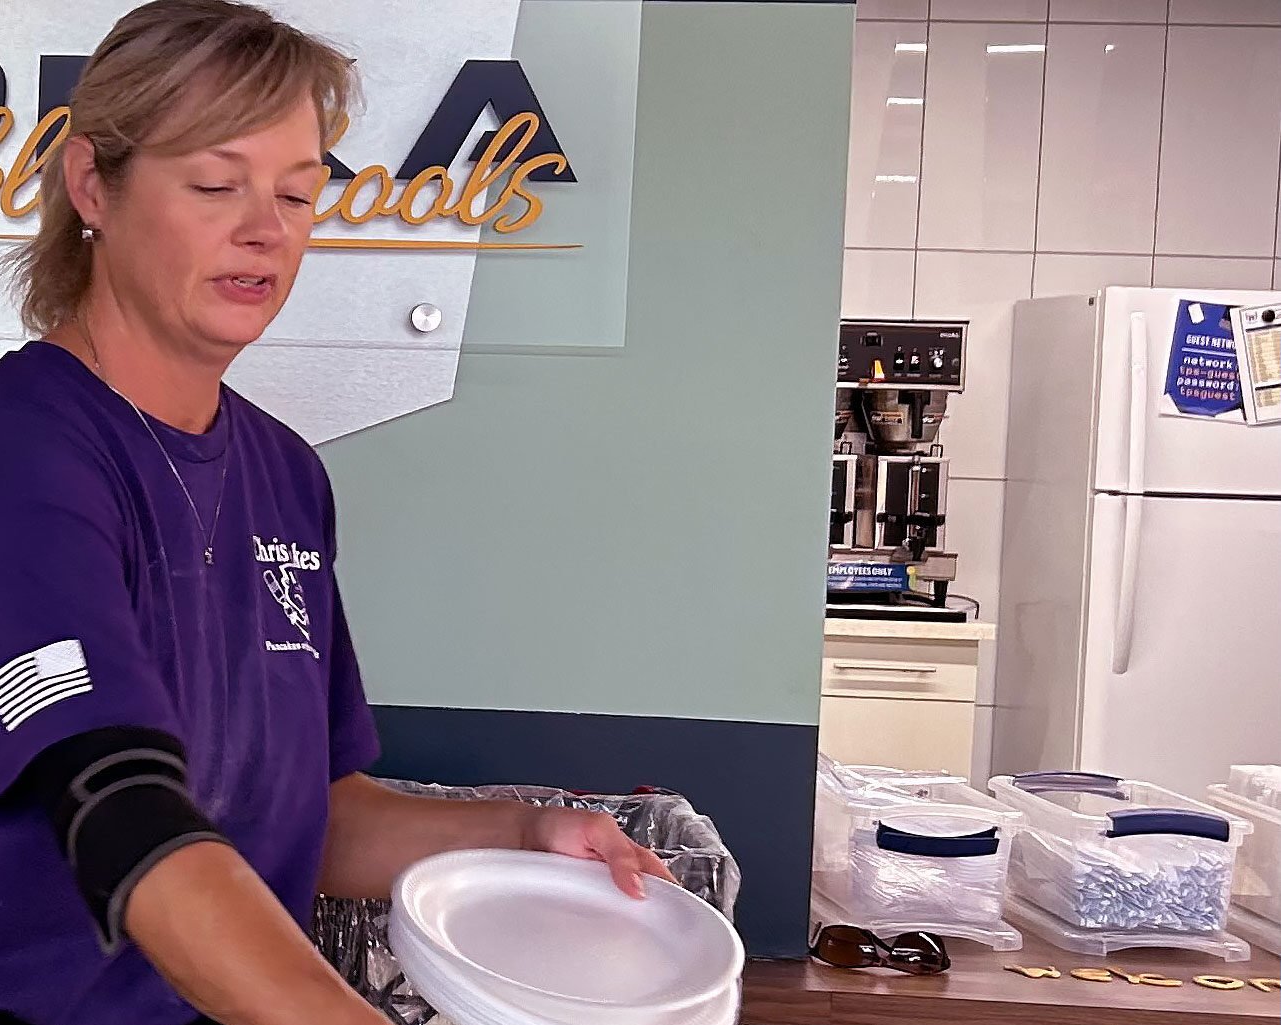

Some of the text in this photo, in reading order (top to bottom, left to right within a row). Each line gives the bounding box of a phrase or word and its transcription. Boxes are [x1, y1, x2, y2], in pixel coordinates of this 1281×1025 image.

[312, 112, 566, 234] ools
[1211, 337, 1237, 350] NETWO
[290, 542, 320, 570] kes
